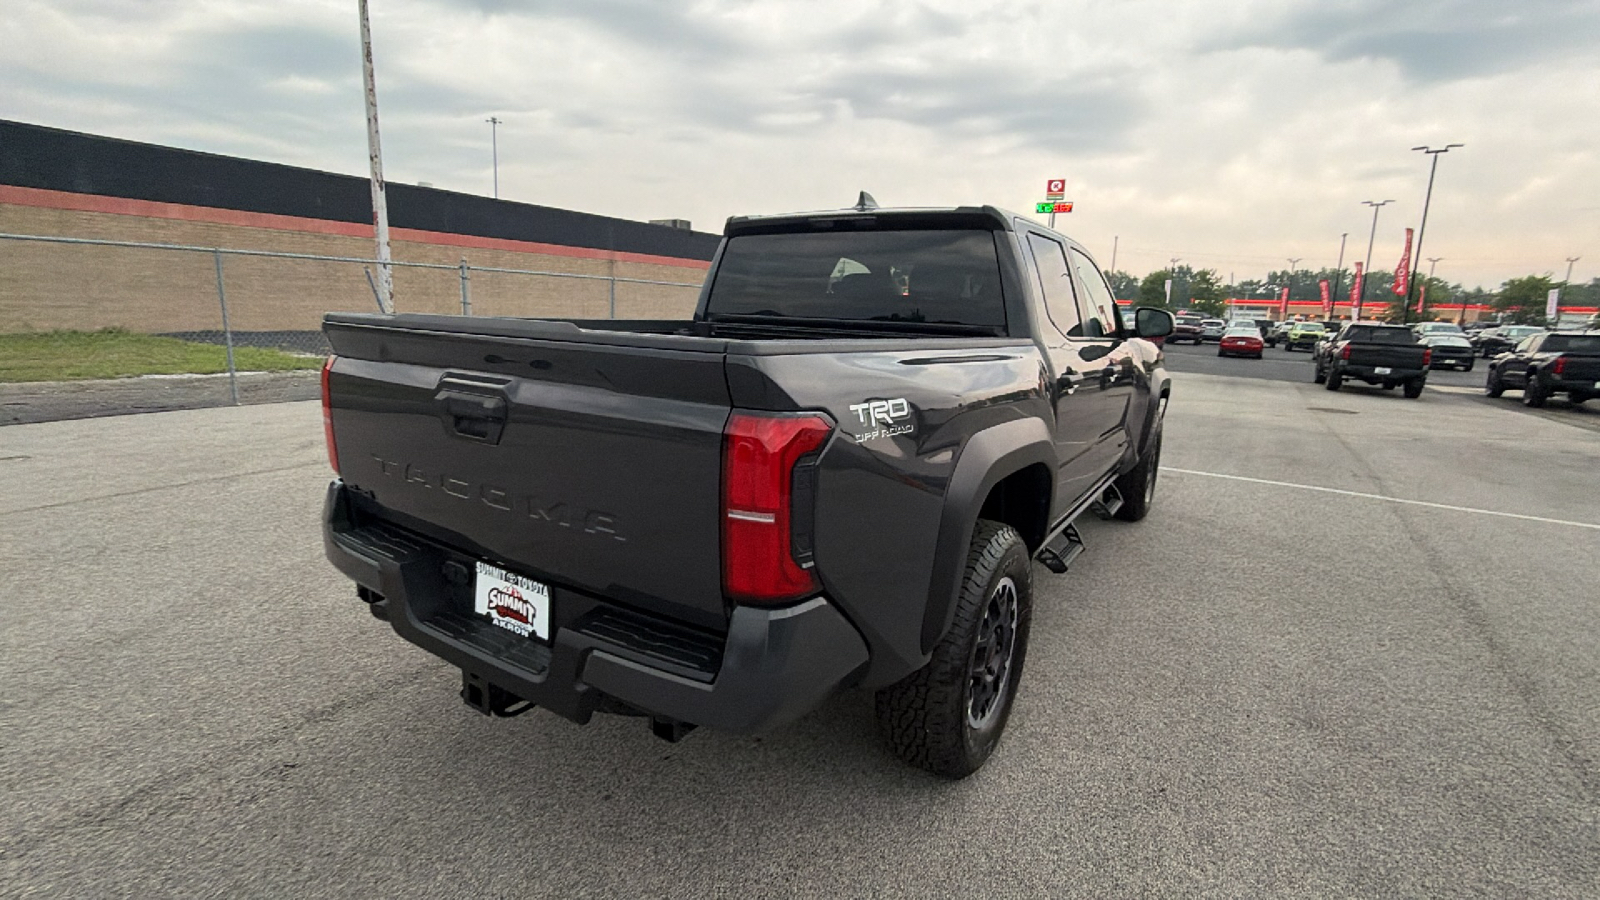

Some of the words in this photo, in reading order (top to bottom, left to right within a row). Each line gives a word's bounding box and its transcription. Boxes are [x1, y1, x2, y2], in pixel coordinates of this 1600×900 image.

[849, 397, 909, 427] TRD
[371, 453, 626, 541] TACOMA
[476, 561, 507, 582] SUMMIT
[518, 576, 549, 597] TOYOTA
[488, 588, 535, 626] SUMMIT
[492, 618, 529, 638] AKRON
